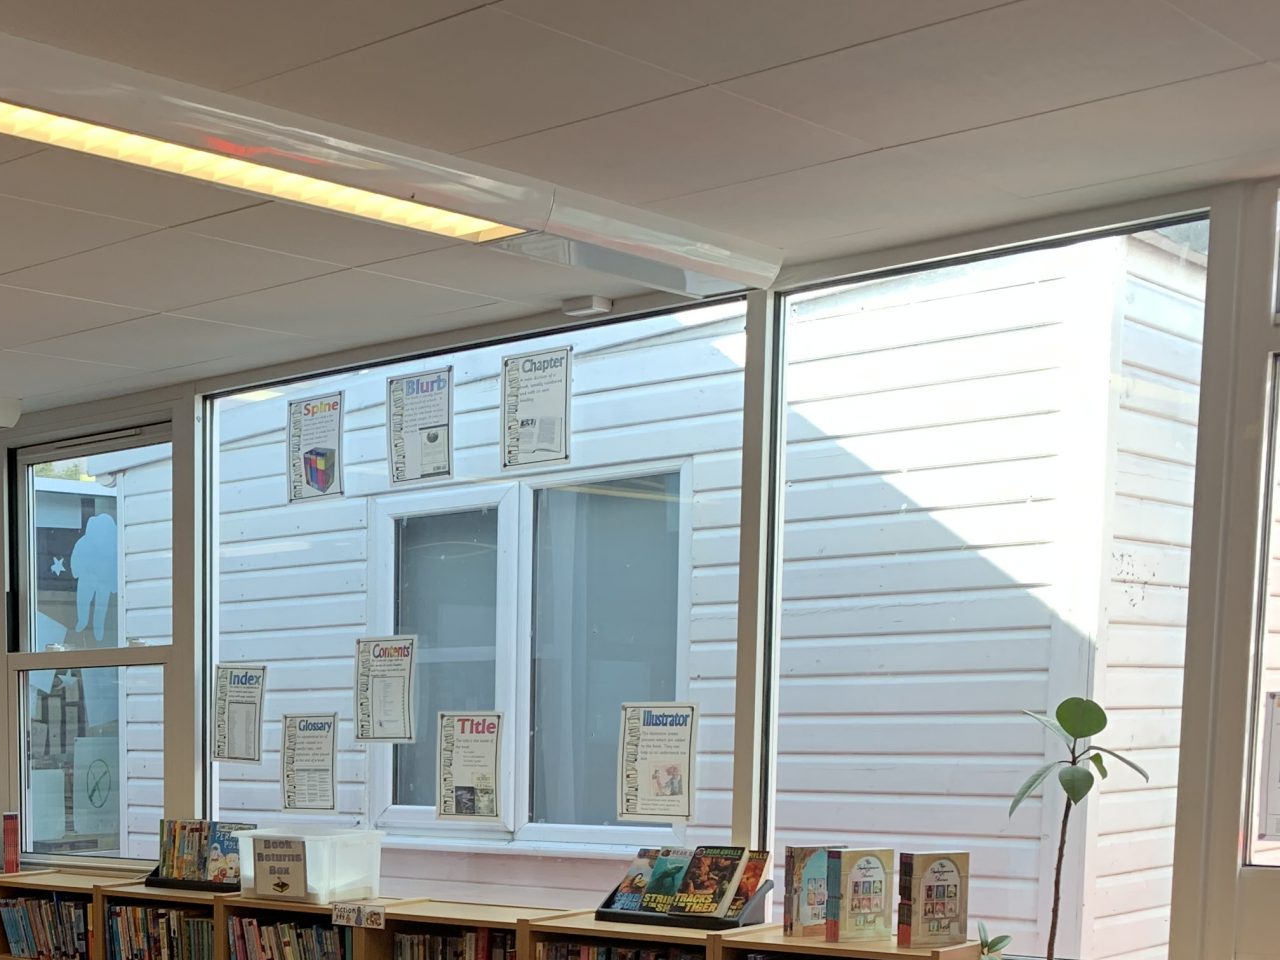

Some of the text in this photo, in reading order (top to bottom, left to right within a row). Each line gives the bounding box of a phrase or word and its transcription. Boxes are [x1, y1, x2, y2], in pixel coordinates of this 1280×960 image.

[522, 356, 565, 373] Chapter
[406, 375, 447, 396] Blurb
[303, 401, 339, 416] Spine
[373, 644, 410, 658] Contents
[229, 671, 261, 685] Index
[643, 710, 690, 727] Illustrator
[298, 720, 332, 733] Glossary
[457, 718, 496, 734] Title
[263, 839, 293, 849] Book
[257, 852, 303, 862] Returns
[269, 865, 290, 875] Box
[675, 893, 714, 903] TRACKS
[334, 904, 357, 914] Fiction
[685, 902, 718, 912] TIGER
